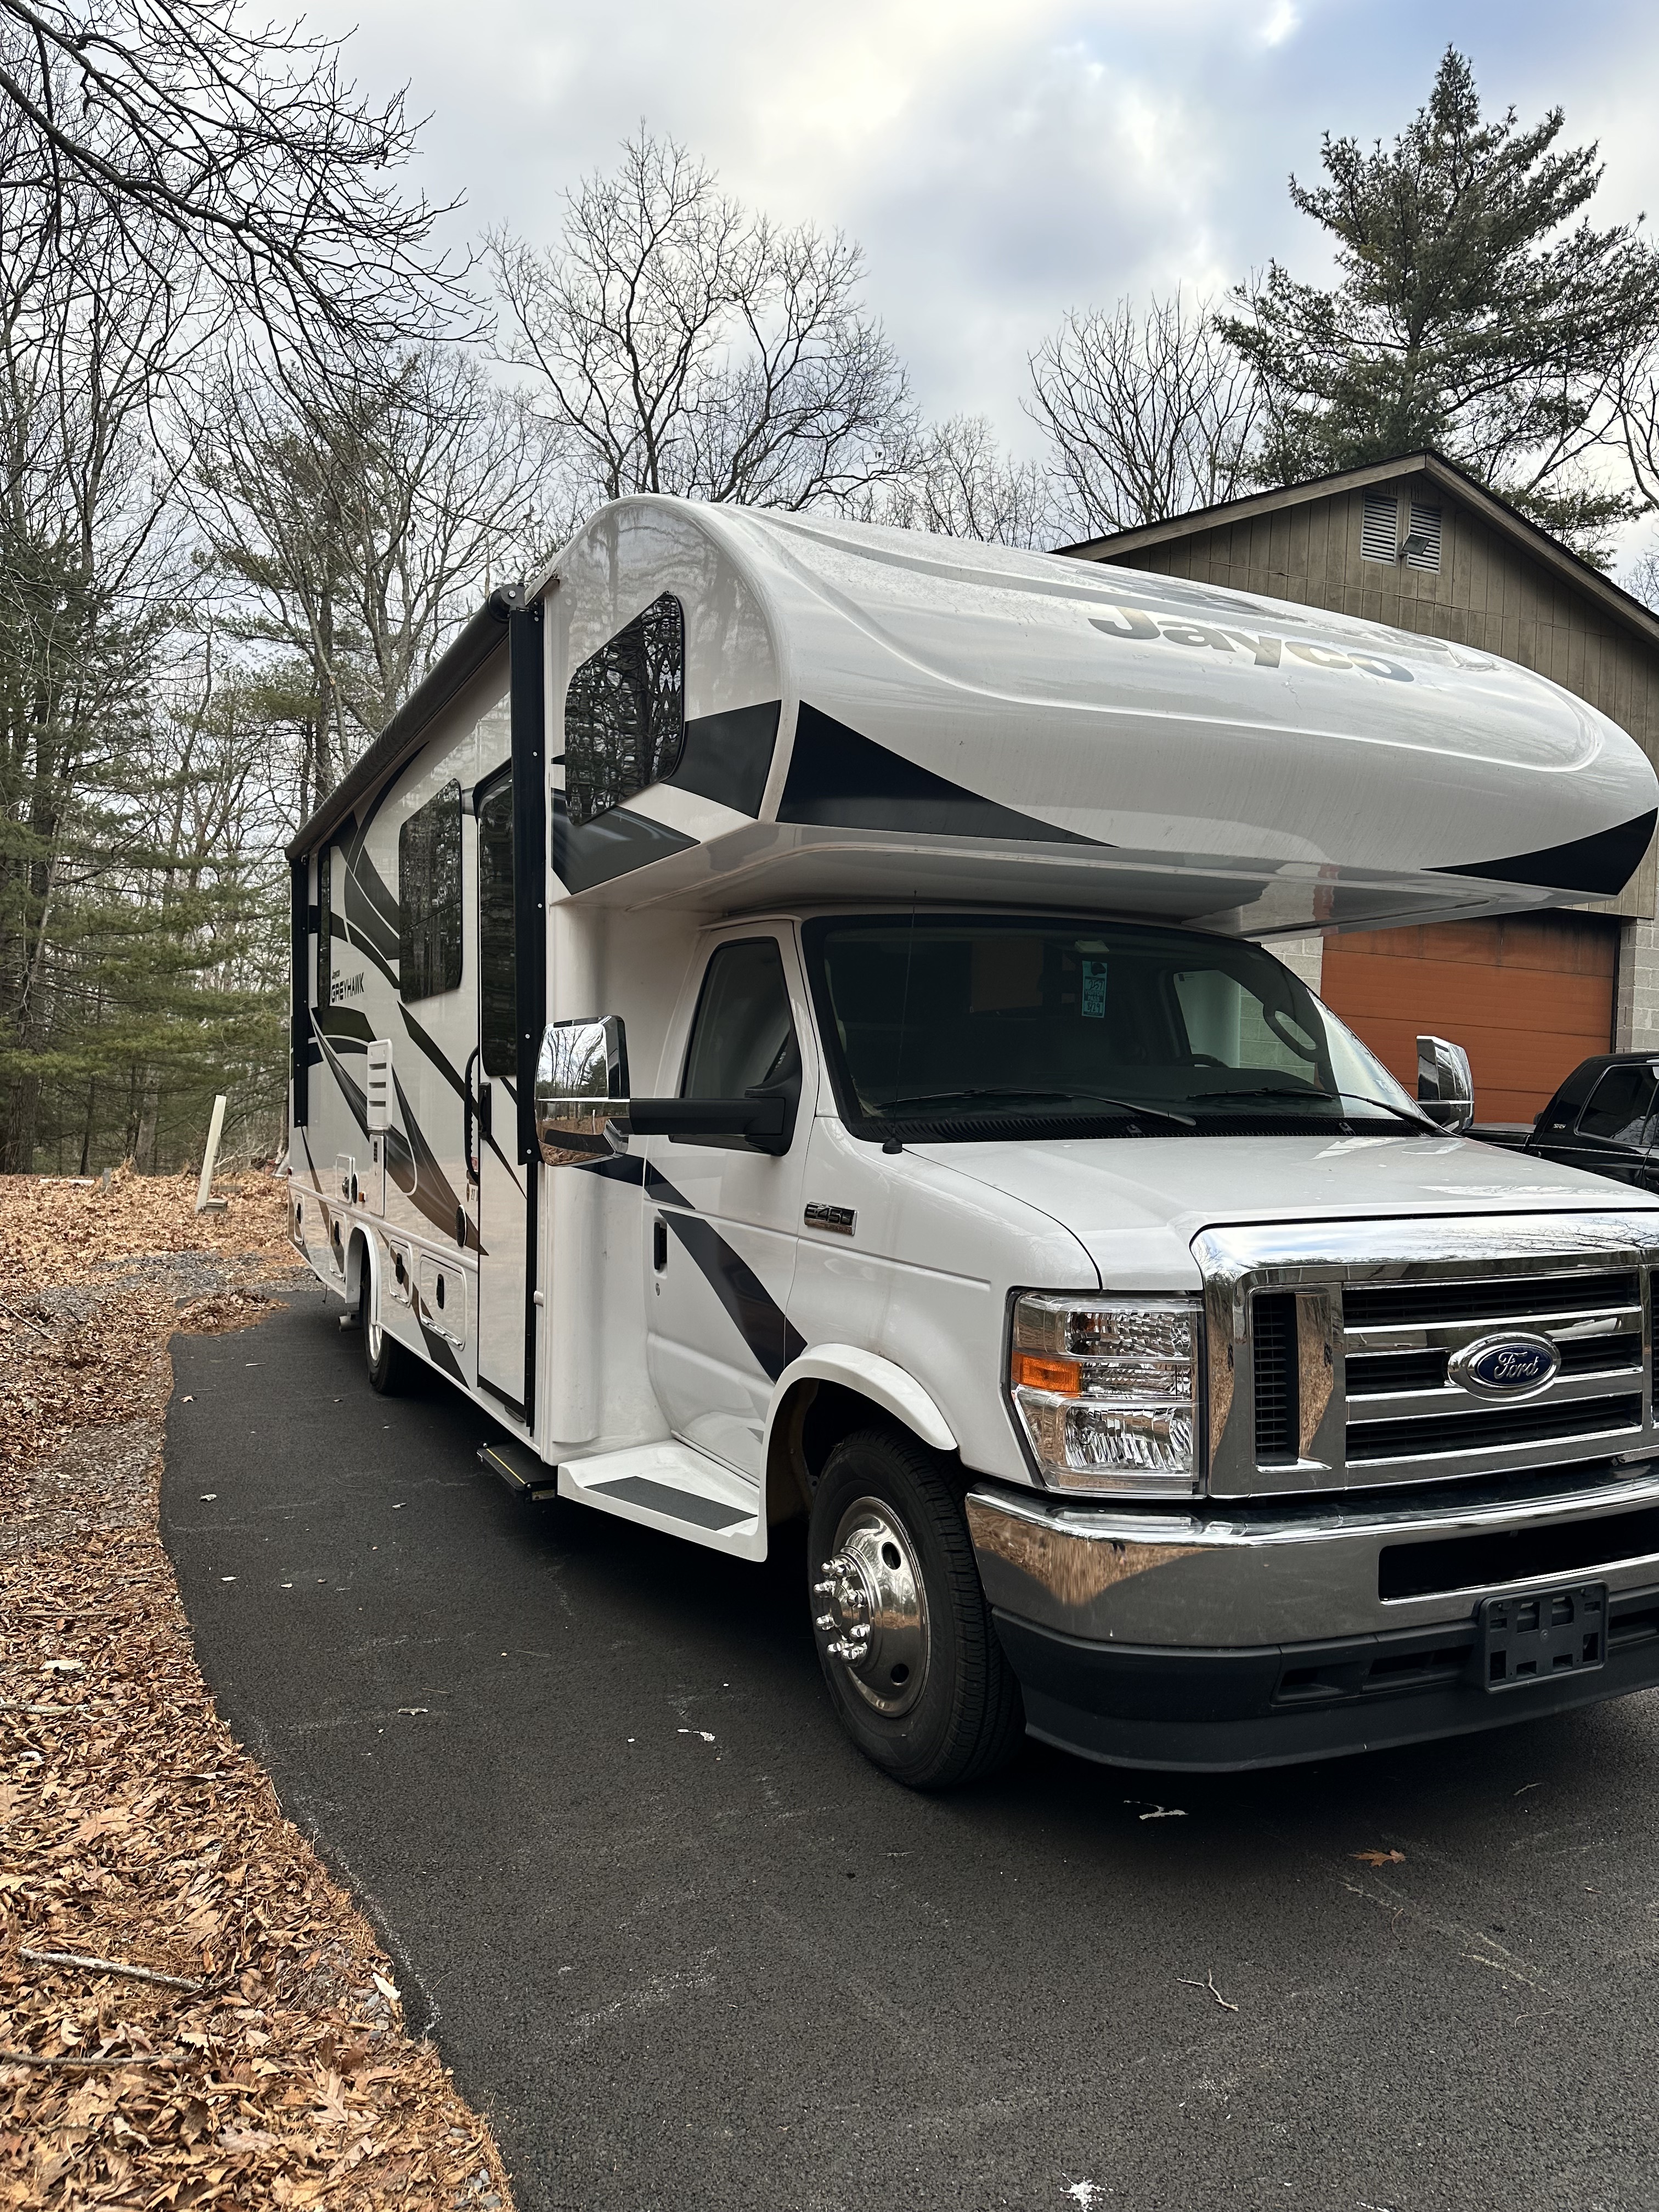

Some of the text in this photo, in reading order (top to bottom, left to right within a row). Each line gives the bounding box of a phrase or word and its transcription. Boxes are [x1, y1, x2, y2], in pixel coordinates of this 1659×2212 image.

[1088, 606, 1414, 682] Jayco
[331, 972, 364, 1003] GREYHAWK
[1088, 980, 1103, 990] 257
[1494, 1351, 1539, 1379] Ford
